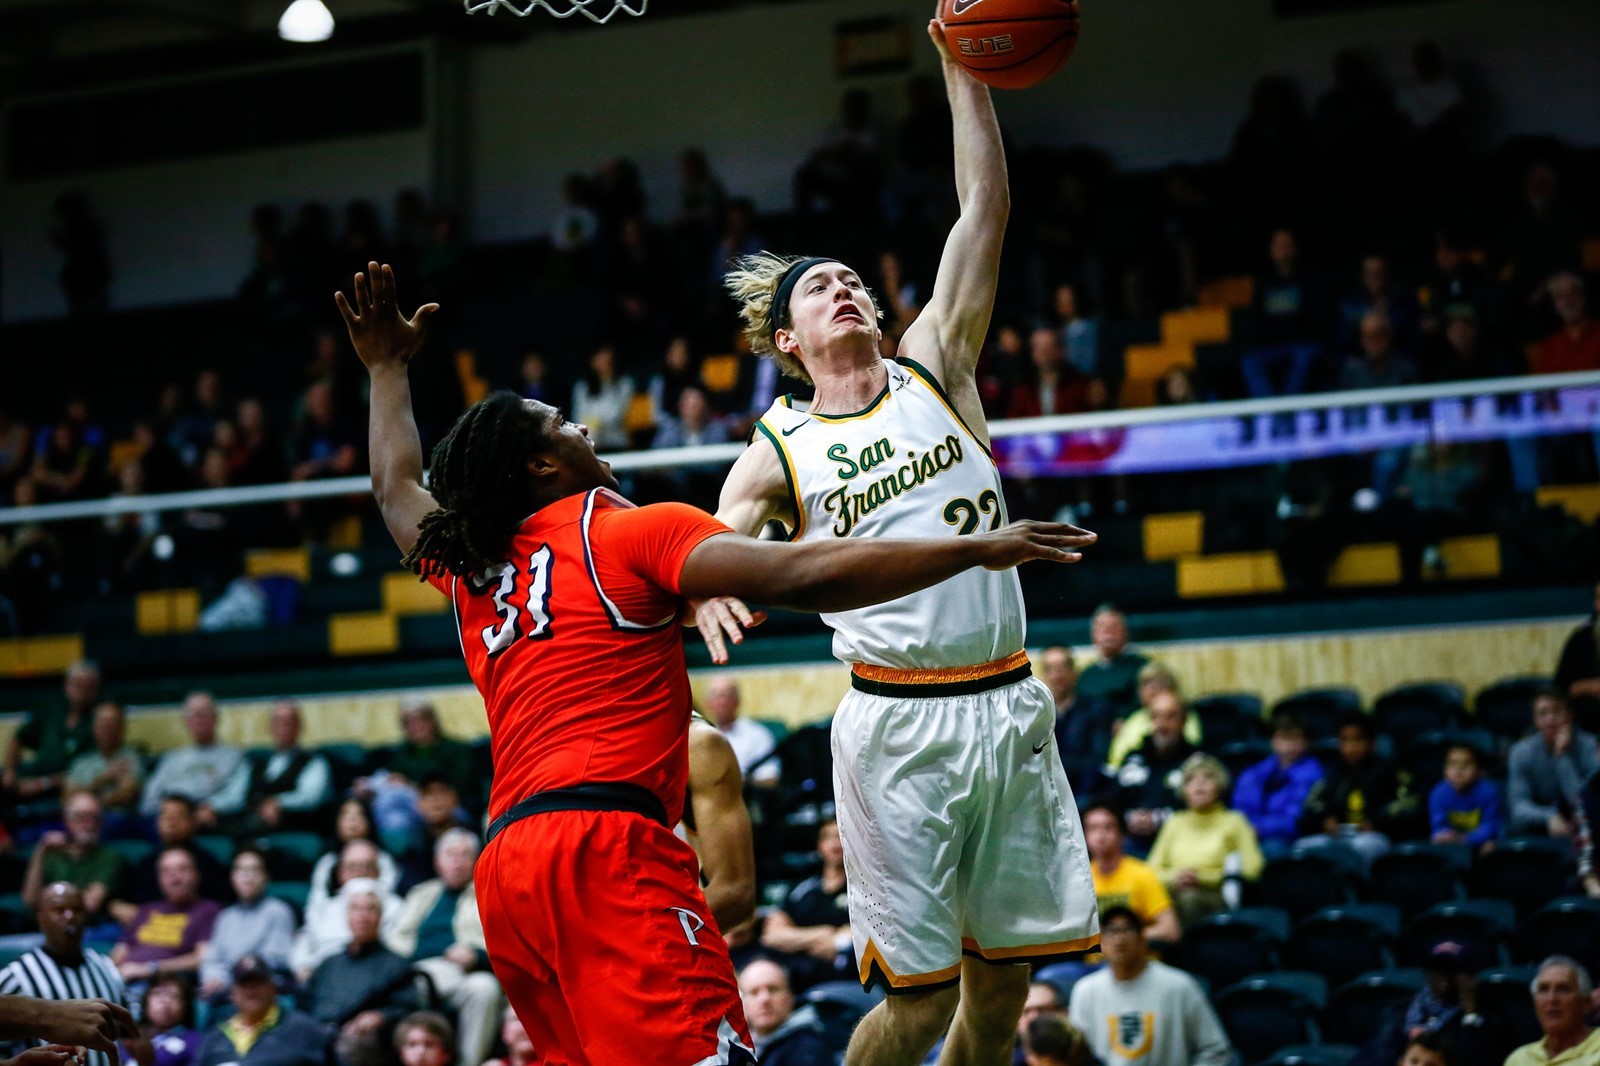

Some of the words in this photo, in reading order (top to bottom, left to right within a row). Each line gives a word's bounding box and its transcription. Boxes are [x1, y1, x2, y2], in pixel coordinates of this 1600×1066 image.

[957, 33, 1015, 55] ELITE
[827, 437, 895, 480] San
[824, 434, 963, 538] Francisco
[472, 541, 555, 658] 31
[668, 906, 705, 946] P
